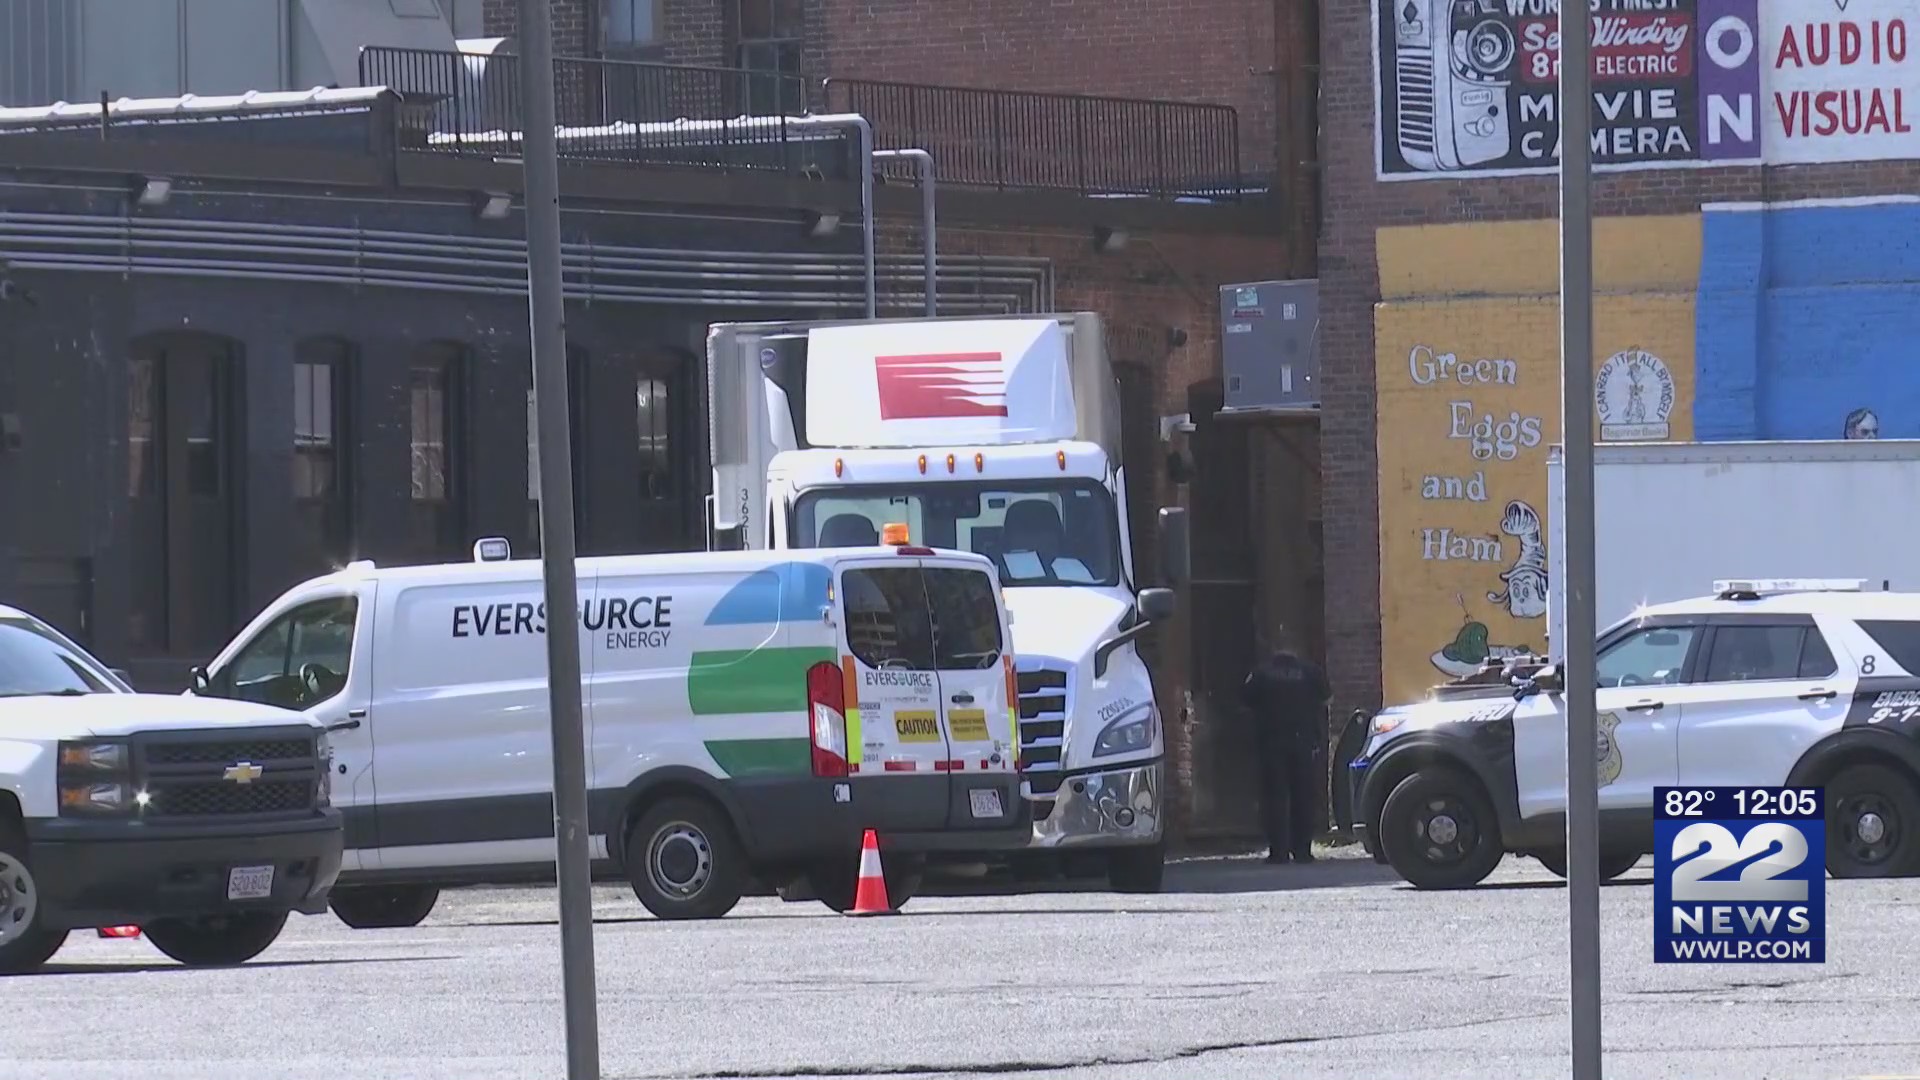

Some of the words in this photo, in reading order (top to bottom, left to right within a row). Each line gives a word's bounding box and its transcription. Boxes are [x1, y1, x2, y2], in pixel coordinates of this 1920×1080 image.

[1591, 16, 1689, 53] Winding
[1775, 19, 1906, 69] AUDIO
[1596, 55, 1678, 75] ELECTRIC
[1519, 89, 1678, 122] MVIE
[1774, 87, 1912, 138] VISUAL
[1408, 344, 1518, 385] Green
[1614, 353, 1626, 366] IT
[1639, 353, 1658, 371] ALL
[1596, 363, 1613, 390] READ
[1656, 367, 1670, 382] BY
[1597, 390, 1609, 413] CAN
[1656, 382, 1673, 421] MYSELF
[1448, 401, 1542, 461] Eggs
[1421, 472, 1488, 501] and
[1422, 527, 1502, 561] Ham
[452, 596, 673, 637] EVERSURCE
[606, 630, 671, 649] ENERGY
[1861, 654, 1876, 674] 8
[865, 671, 932, 687] EVERSOURCE
[896, 718, 938, 735] CAUTION
